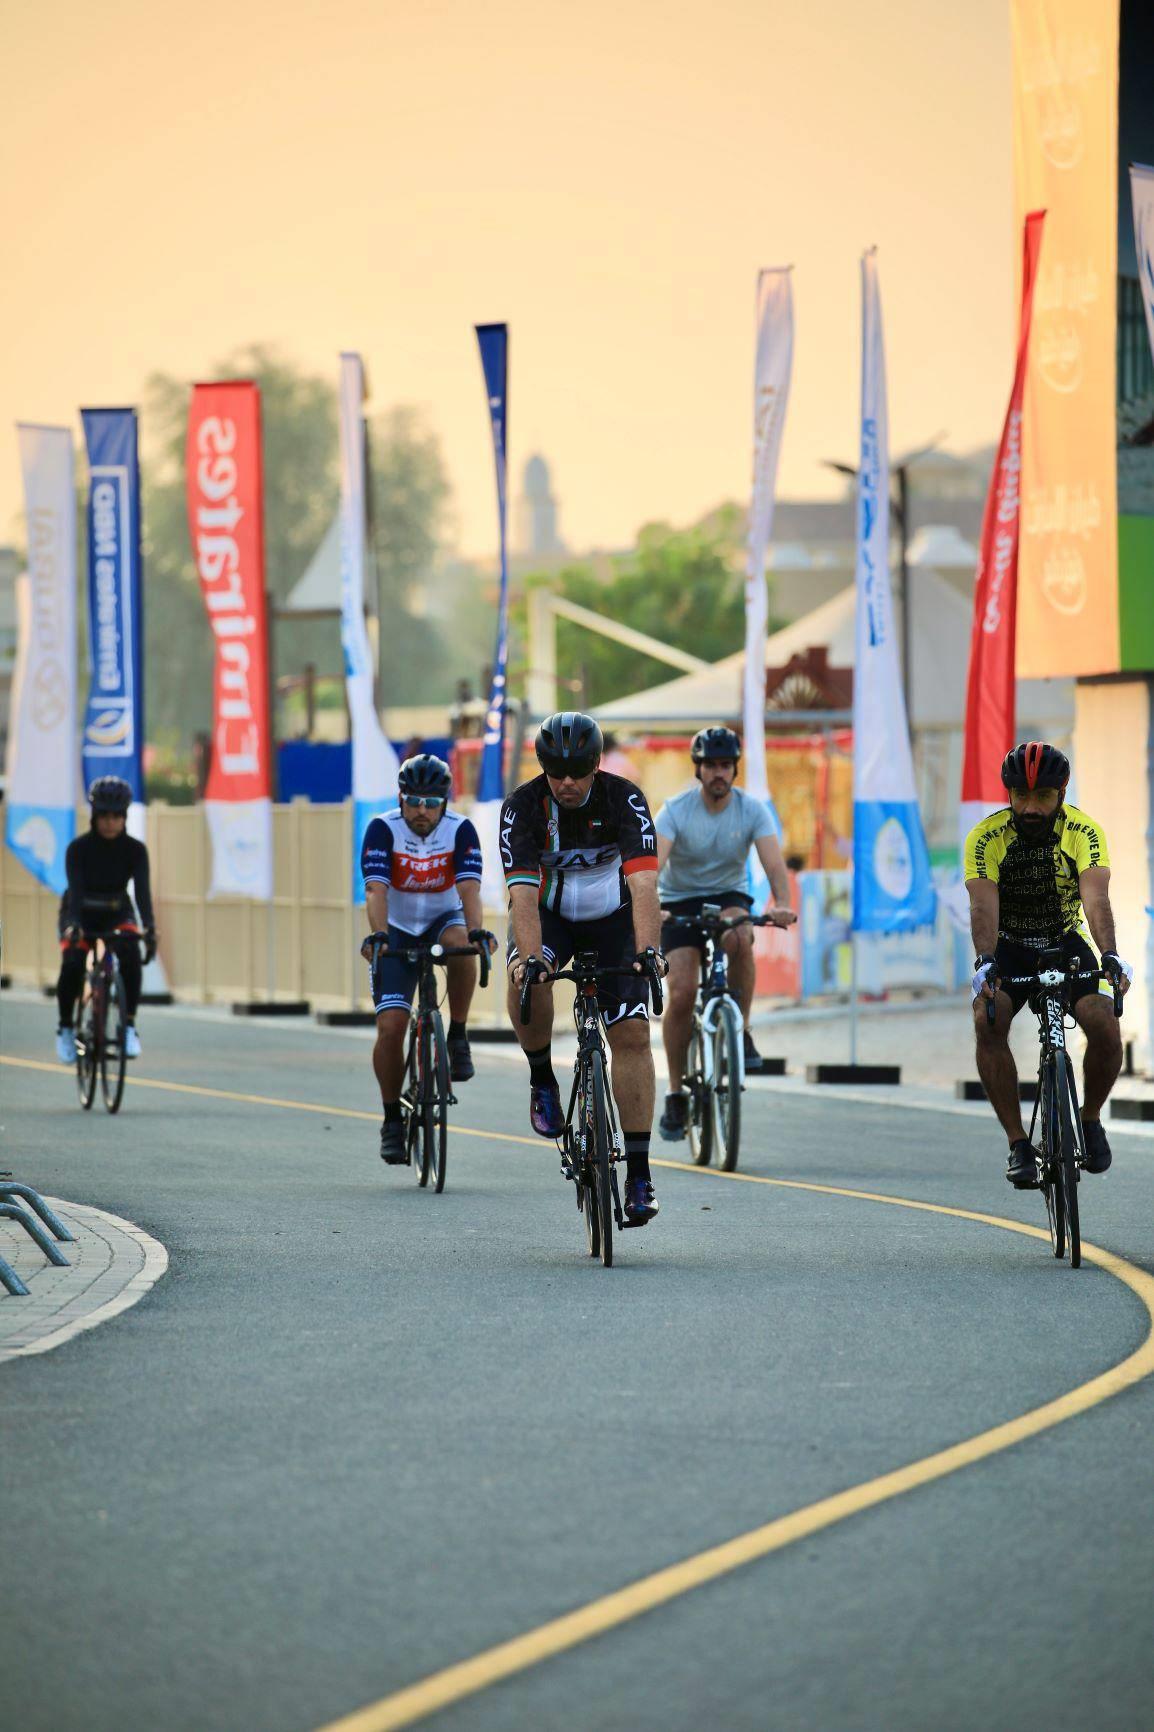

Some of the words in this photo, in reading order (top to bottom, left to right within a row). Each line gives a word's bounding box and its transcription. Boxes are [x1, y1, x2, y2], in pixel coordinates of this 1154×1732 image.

[500, 806, 517, 868] UAE
[627, 793, 655, 851] UAE
[398, 856, 449, 872] TREK
